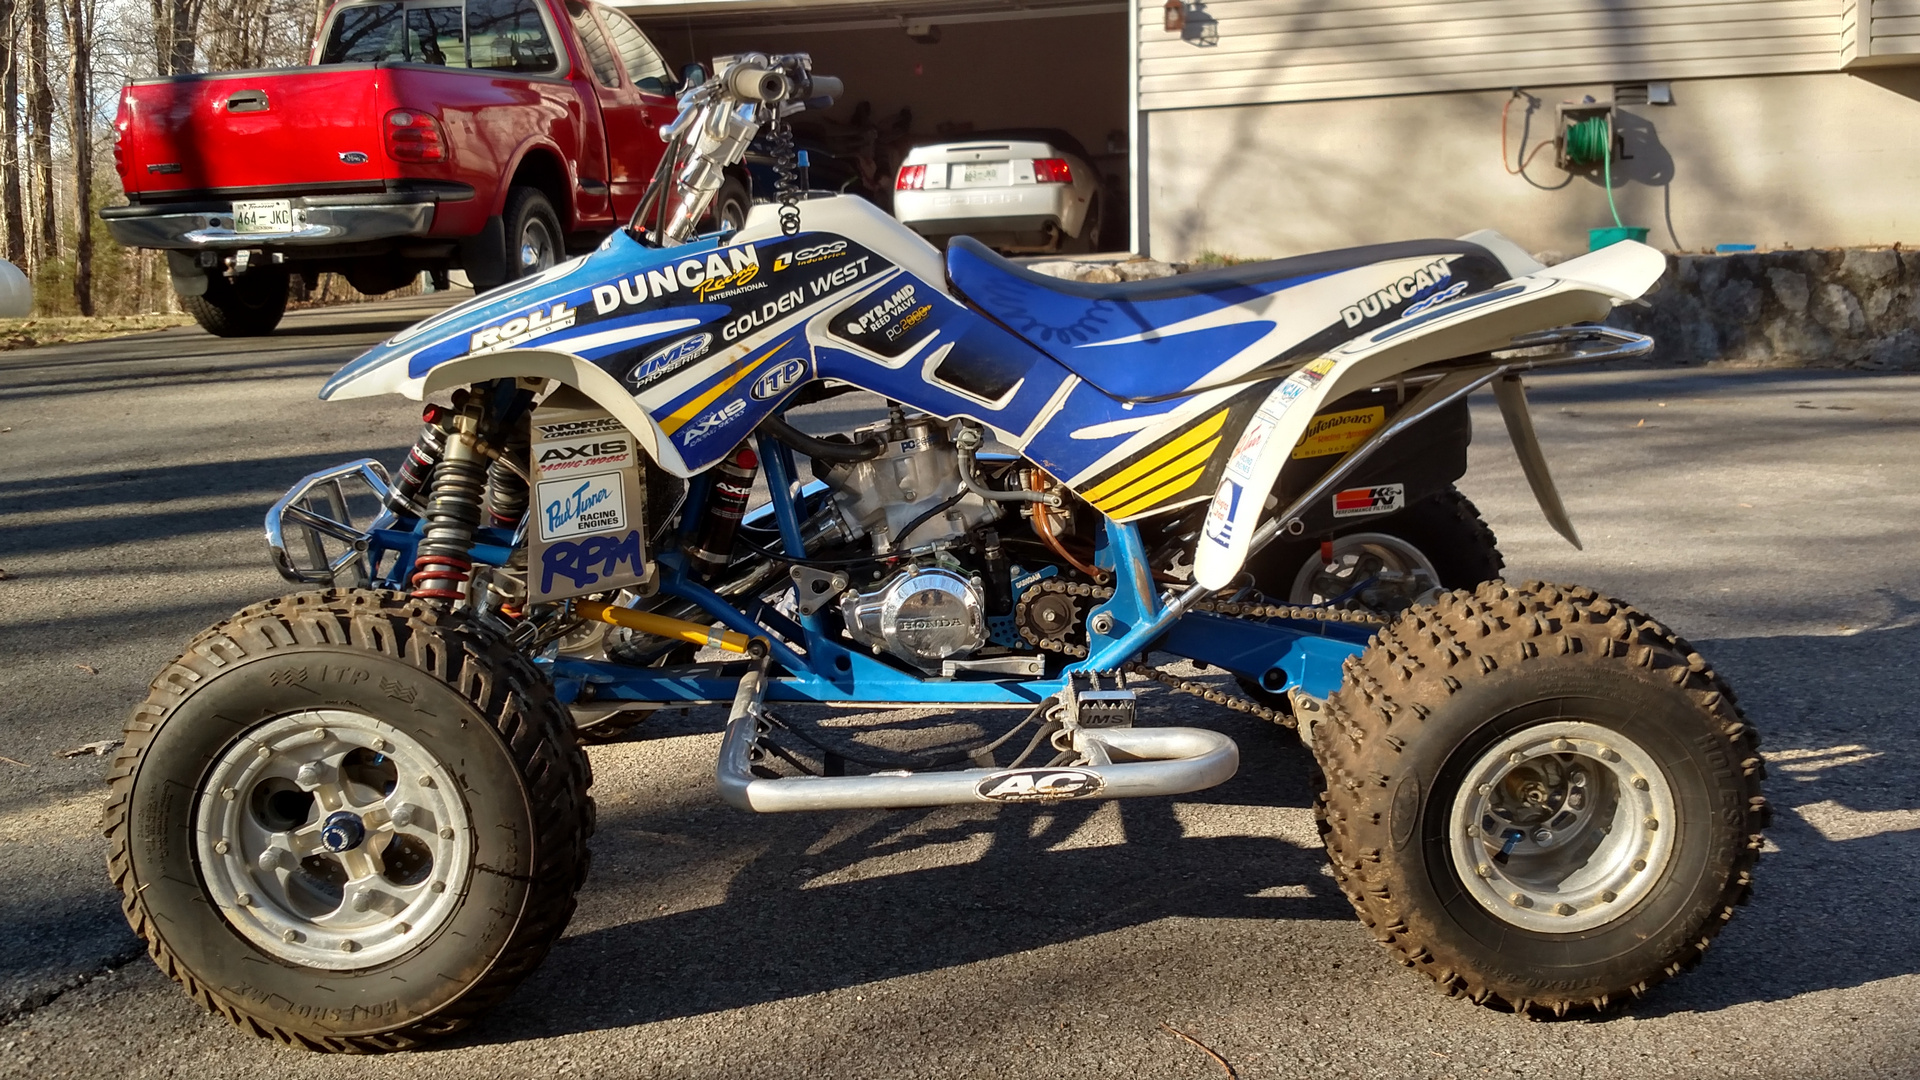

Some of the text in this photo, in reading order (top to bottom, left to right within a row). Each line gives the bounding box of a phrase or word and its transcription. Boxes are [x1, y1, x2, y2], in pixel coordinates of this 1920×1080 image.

[591, 244, 760, 316] DUNCAN
[692, 262, 760, 303] Racing
[708, 281, 769, 302] INTERNATIONAL
[722, 256, 869, 341] GOLDEN WEST
[1339, 257, 1452, 329] DUNCAN
[858, 284, 915, 329] PYRAMID
[869, 314, 891, 332] REED
[890, 296, 917, 317] VALVE
[470, 301, 577, 353] ROLL
[472, 319, 572, 356] ESIGN
[637, 333, 706, 381] IMS
[757, 359, 800, 399] ITP
[683, 398, 747, 447] AXIS
[538, 440, 628, 463] AXIS
[545, 480, 613, 533] Paul Turner
[1335, 507, 1372, 515] PERFORMANCE
[1368, 486, 1402, 507] K&N
[577, 516, 619, 530] ENGINES
[579, 509, 616, 522] RACING
[541, 530, 644, 595] RPM
[900, 618, 965, 631] HONDA
[320, 664, 370, 685] ITP
[1085, 714, 1124, 725] IMS
[985, 772, 1088, 797] AC
